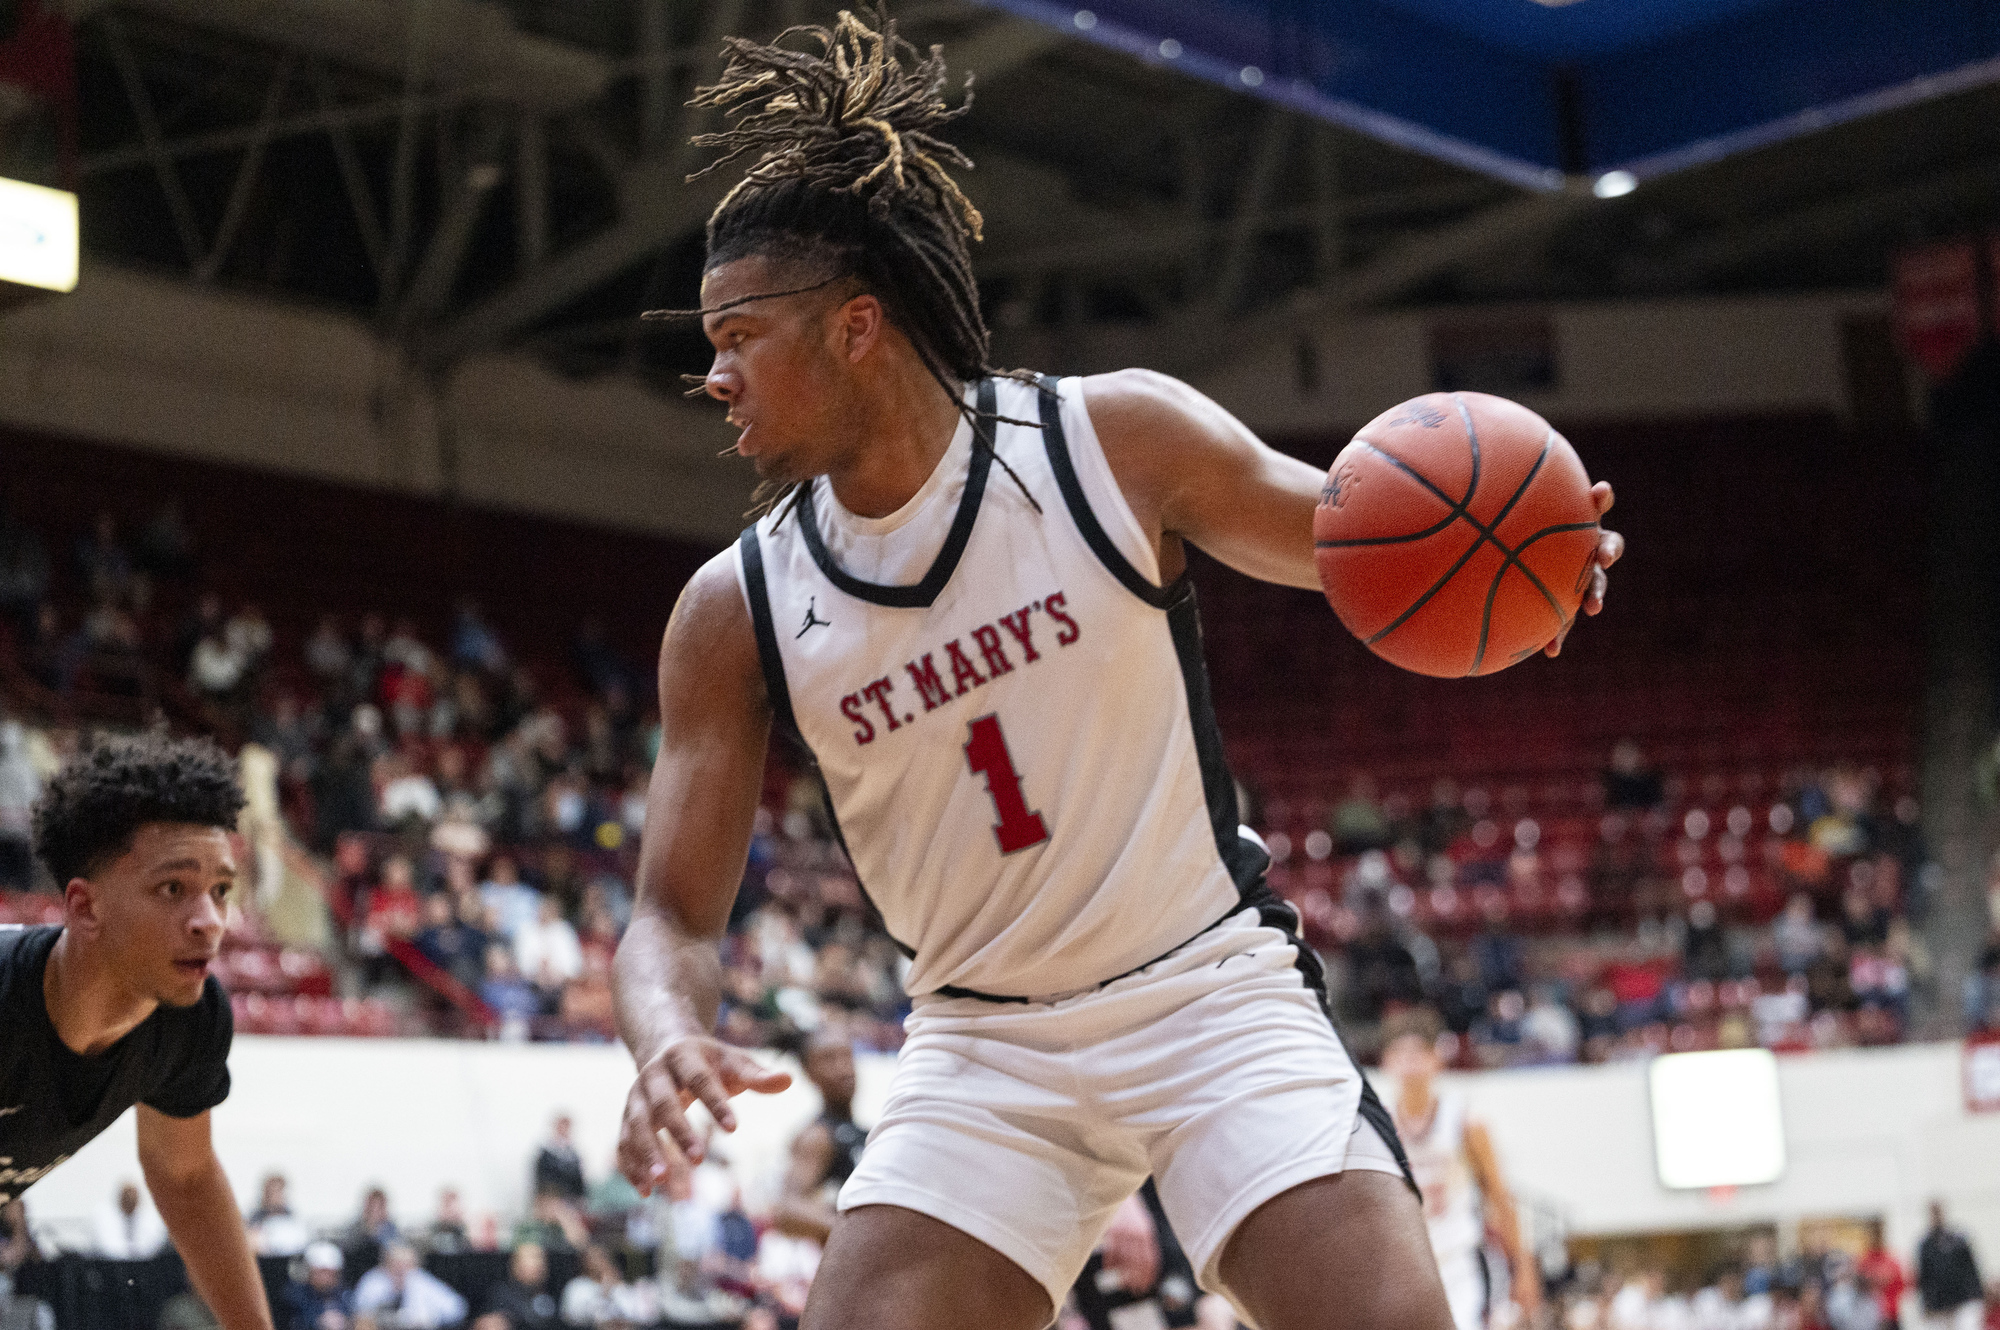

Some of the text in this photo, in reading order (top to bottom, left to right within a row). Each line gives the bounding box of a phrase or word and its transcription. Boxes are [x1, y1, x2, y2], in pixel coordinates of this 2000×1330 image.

[840, 590, 1081, 746] ST. MARY'S
[962, 710, 1051, 857] 1
